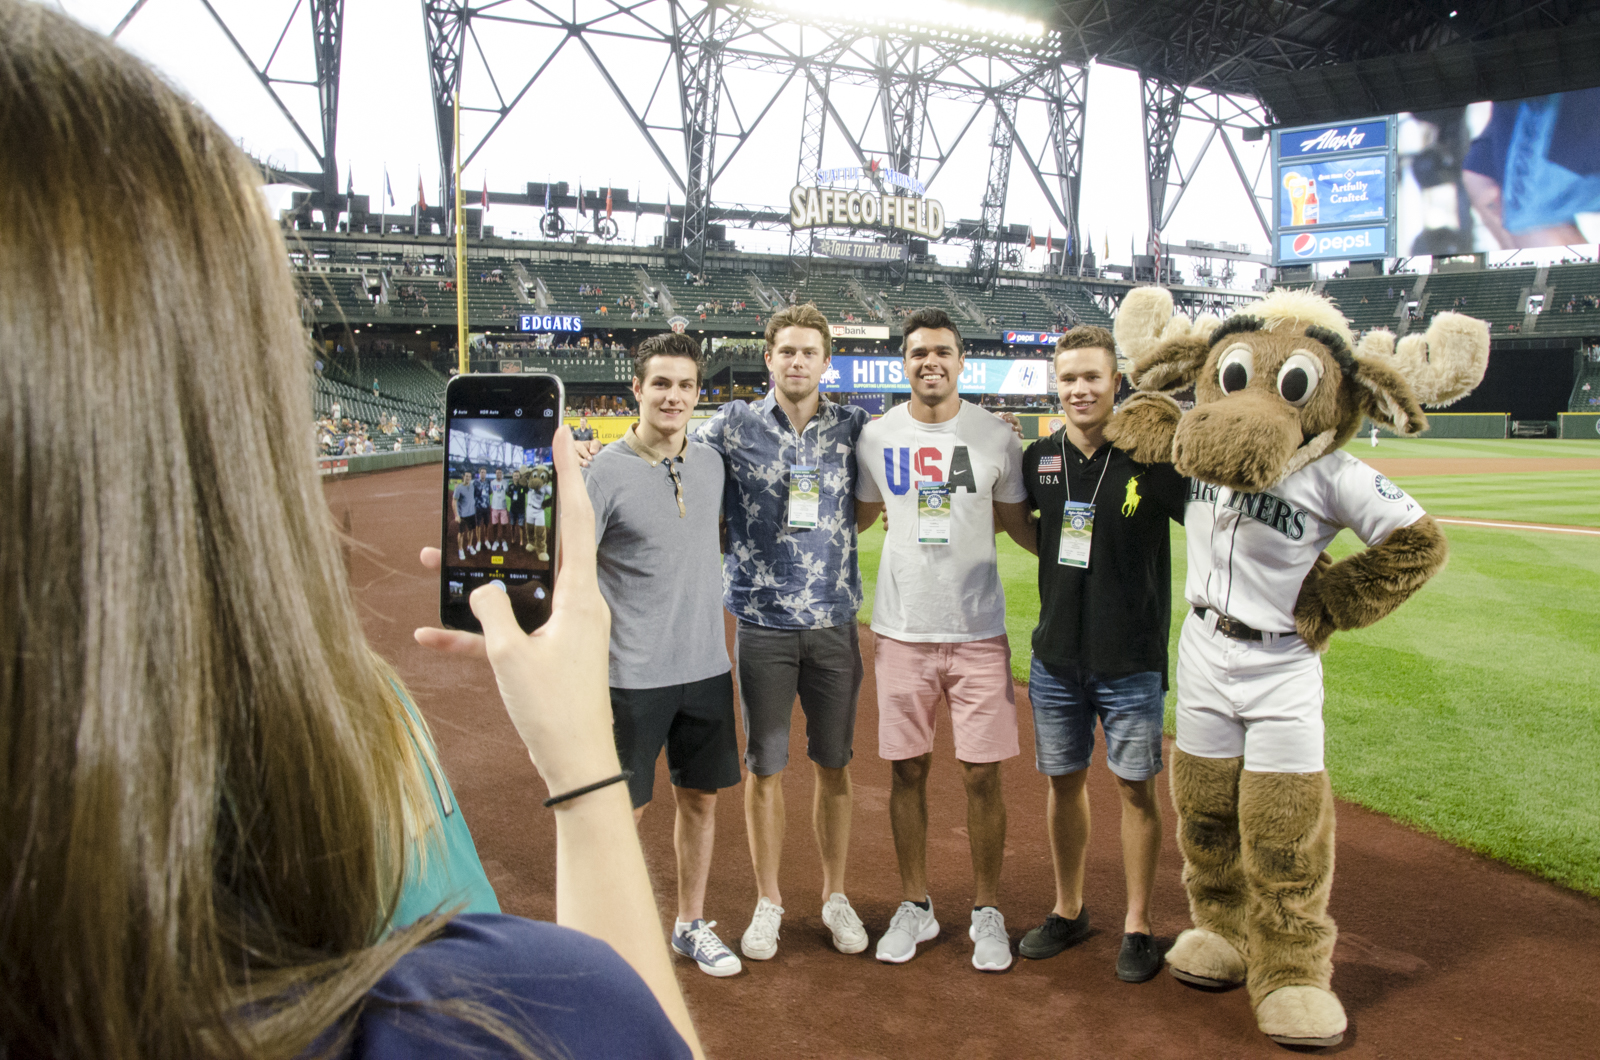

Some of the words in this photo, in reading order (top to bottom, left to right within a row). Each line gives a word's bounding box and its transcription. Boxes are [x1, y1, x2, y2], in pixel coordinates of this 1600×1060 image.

[1300, 127, 1365, 151] Alaska
[817, 167, 860, 185] SEATTLE
[884, 168, 926, 195] MARINERS
[1331, 181, 1368, 193] Artfully
[1330, 191, 1369, 204] Crafted.
[790, 185, 877, 229] SAFECO
[881, 193, 945, 239] FIELD
[831, 240, 852, 256] TRUE
[853, 244, 864, 257] TO
[865, 245, 881, 258] THE
[881, 244, 902, 259] BLUE
[1319, 231, 1371, 253] pepsi
[672, 323, 685, 333] 42
[1017, 334, 1035, 343] pepsi
[853, 360, 902, 383] HITS
[883, 446, 977, 496] USA
[1040, 474, 1059, 484] USA
[1186, 477, 1308, 541] ARINERS
